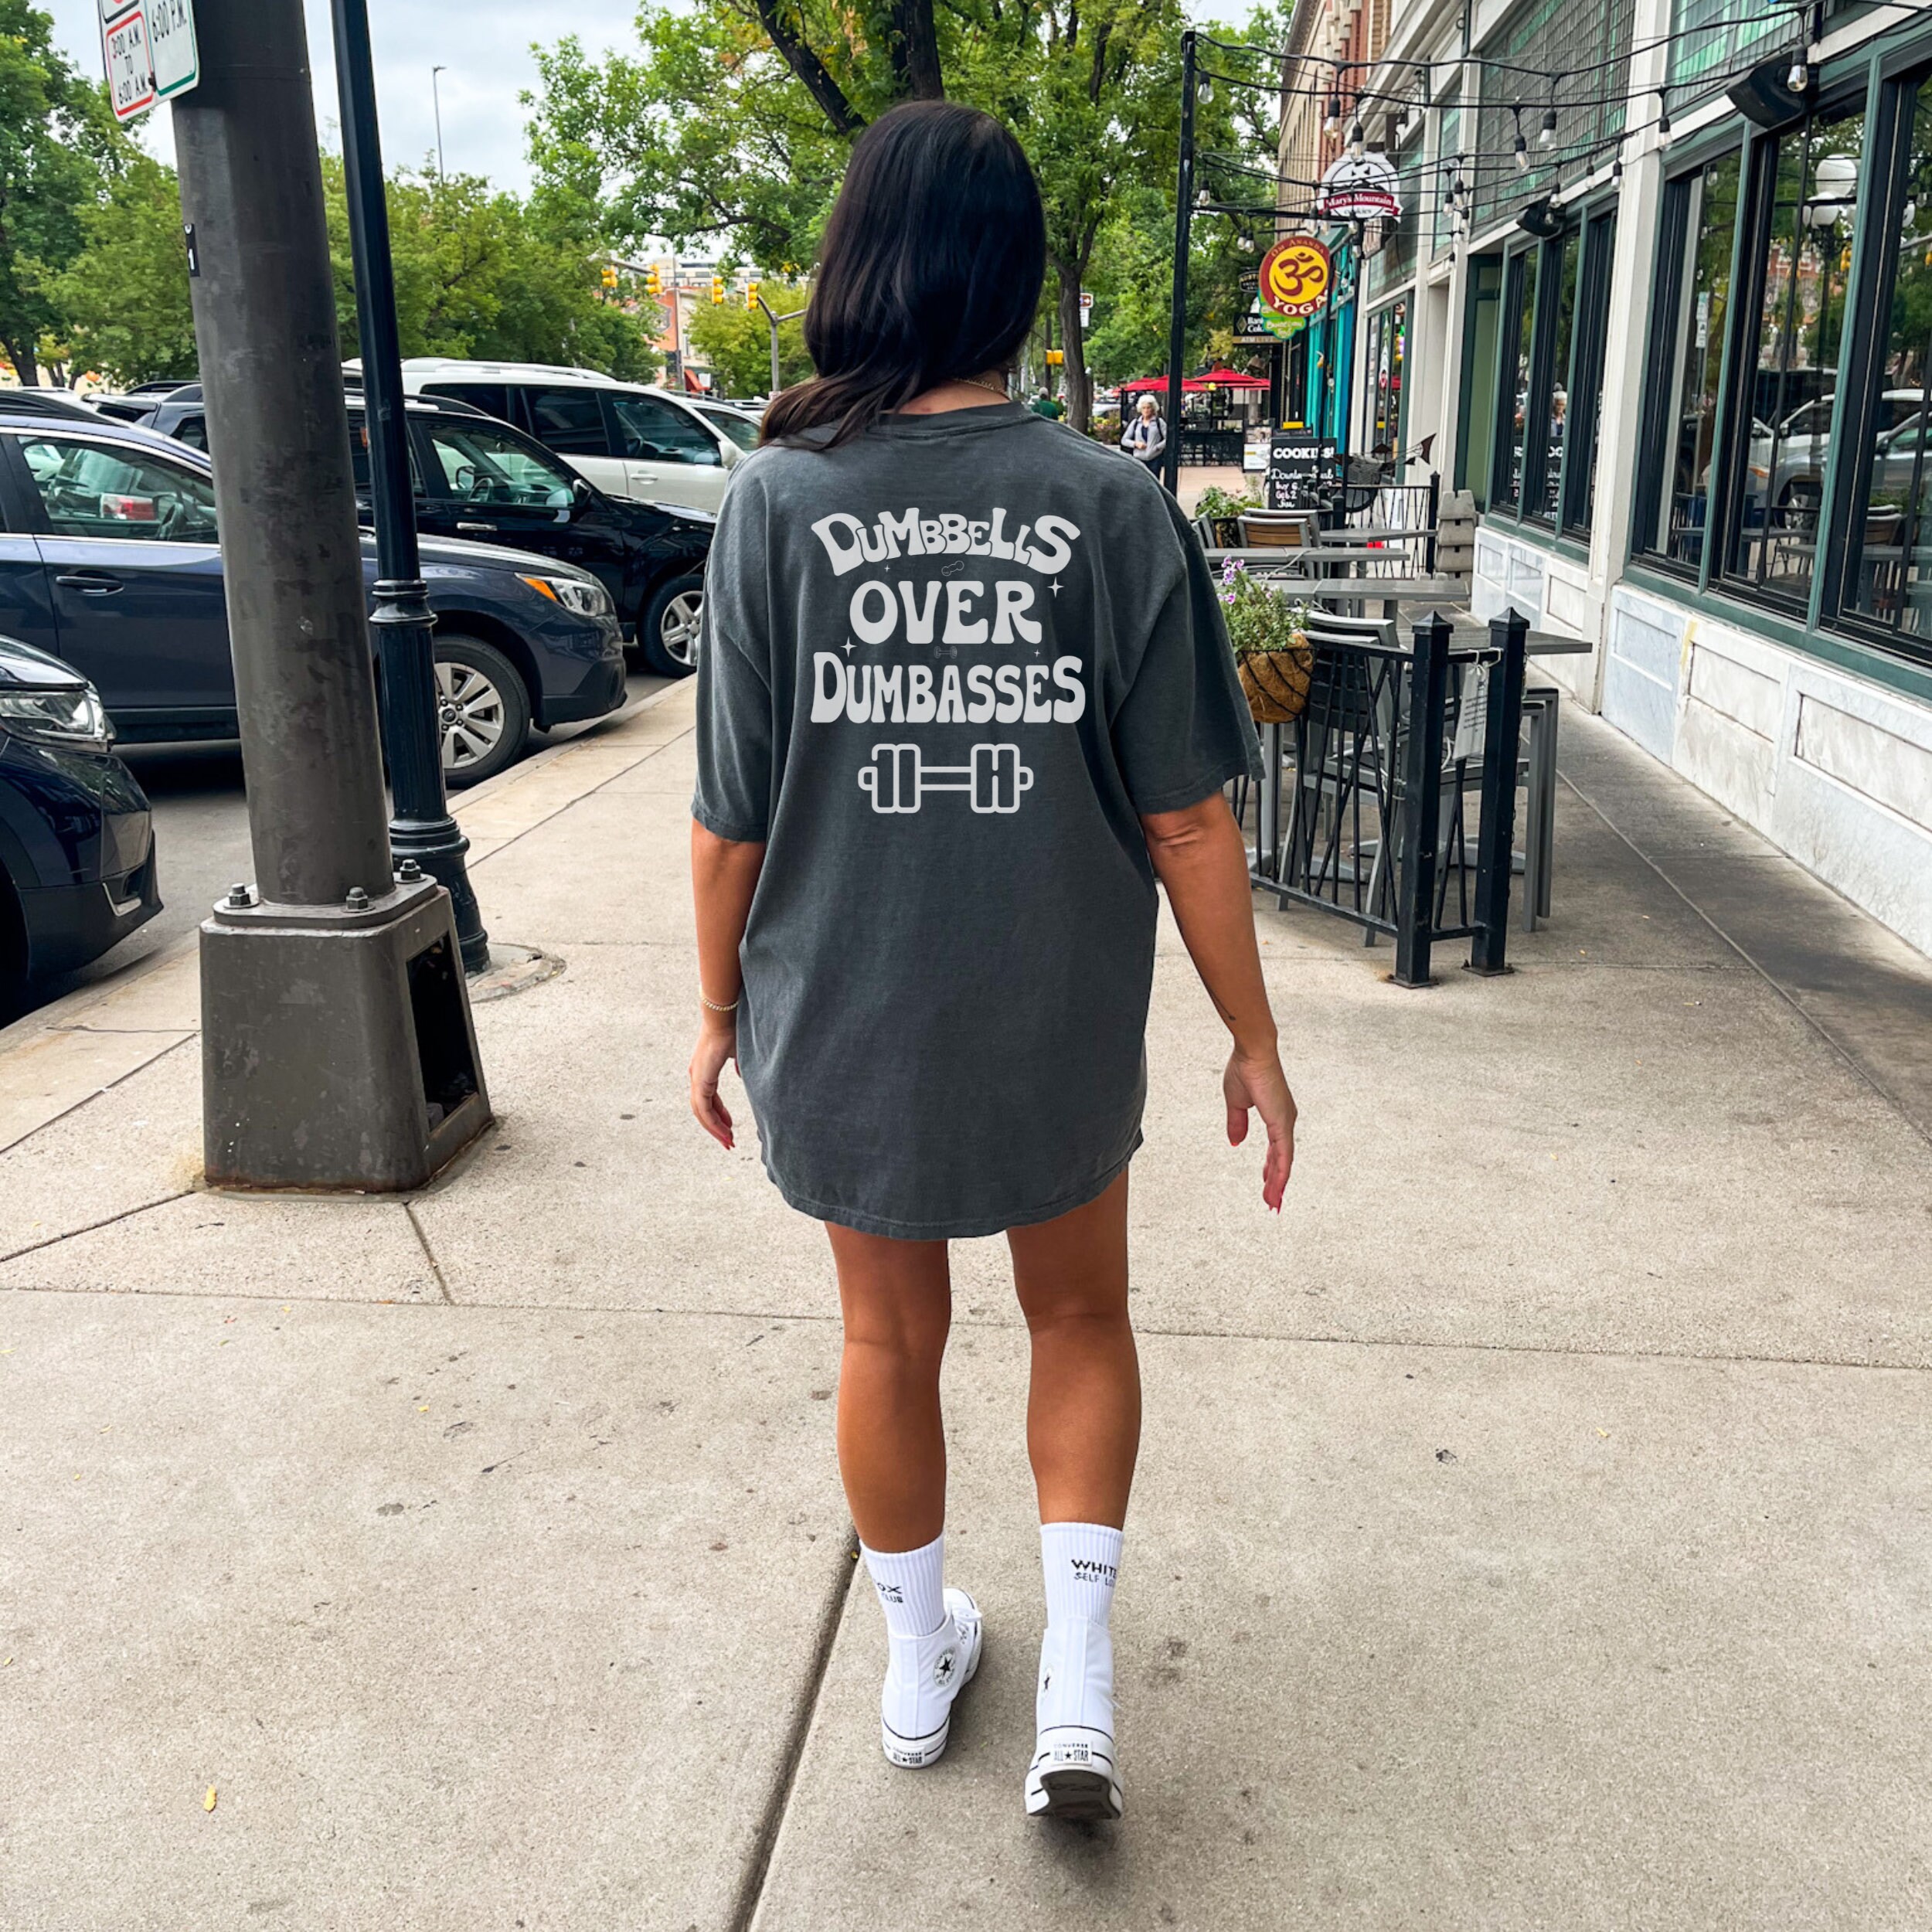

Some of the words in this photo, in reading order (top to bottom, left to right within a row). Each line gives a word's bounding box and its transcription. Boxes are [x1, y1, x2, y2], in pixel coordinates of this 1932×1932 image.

[151, 1, 169, 43] 6:00
[124, 54, 134, 75] TO
[118, 80, 132, 104] 6:00
[1353, 192, 1393, 206] Mountain
[1273, 289, 1328, 315] YOGA
[1290, 490, 1298, 499] 2
[811, 507, 1080, 576] DUMBBELLS
[849, 580, 1043, 645] OVER
[811, 651, 1086, 723] DUMBASSES
[1074, 1571, 1100, 1583] SELF
[1053, 1750, 1064, 1761] ALL
[1073, 1749, 1089, 1761] STAR
